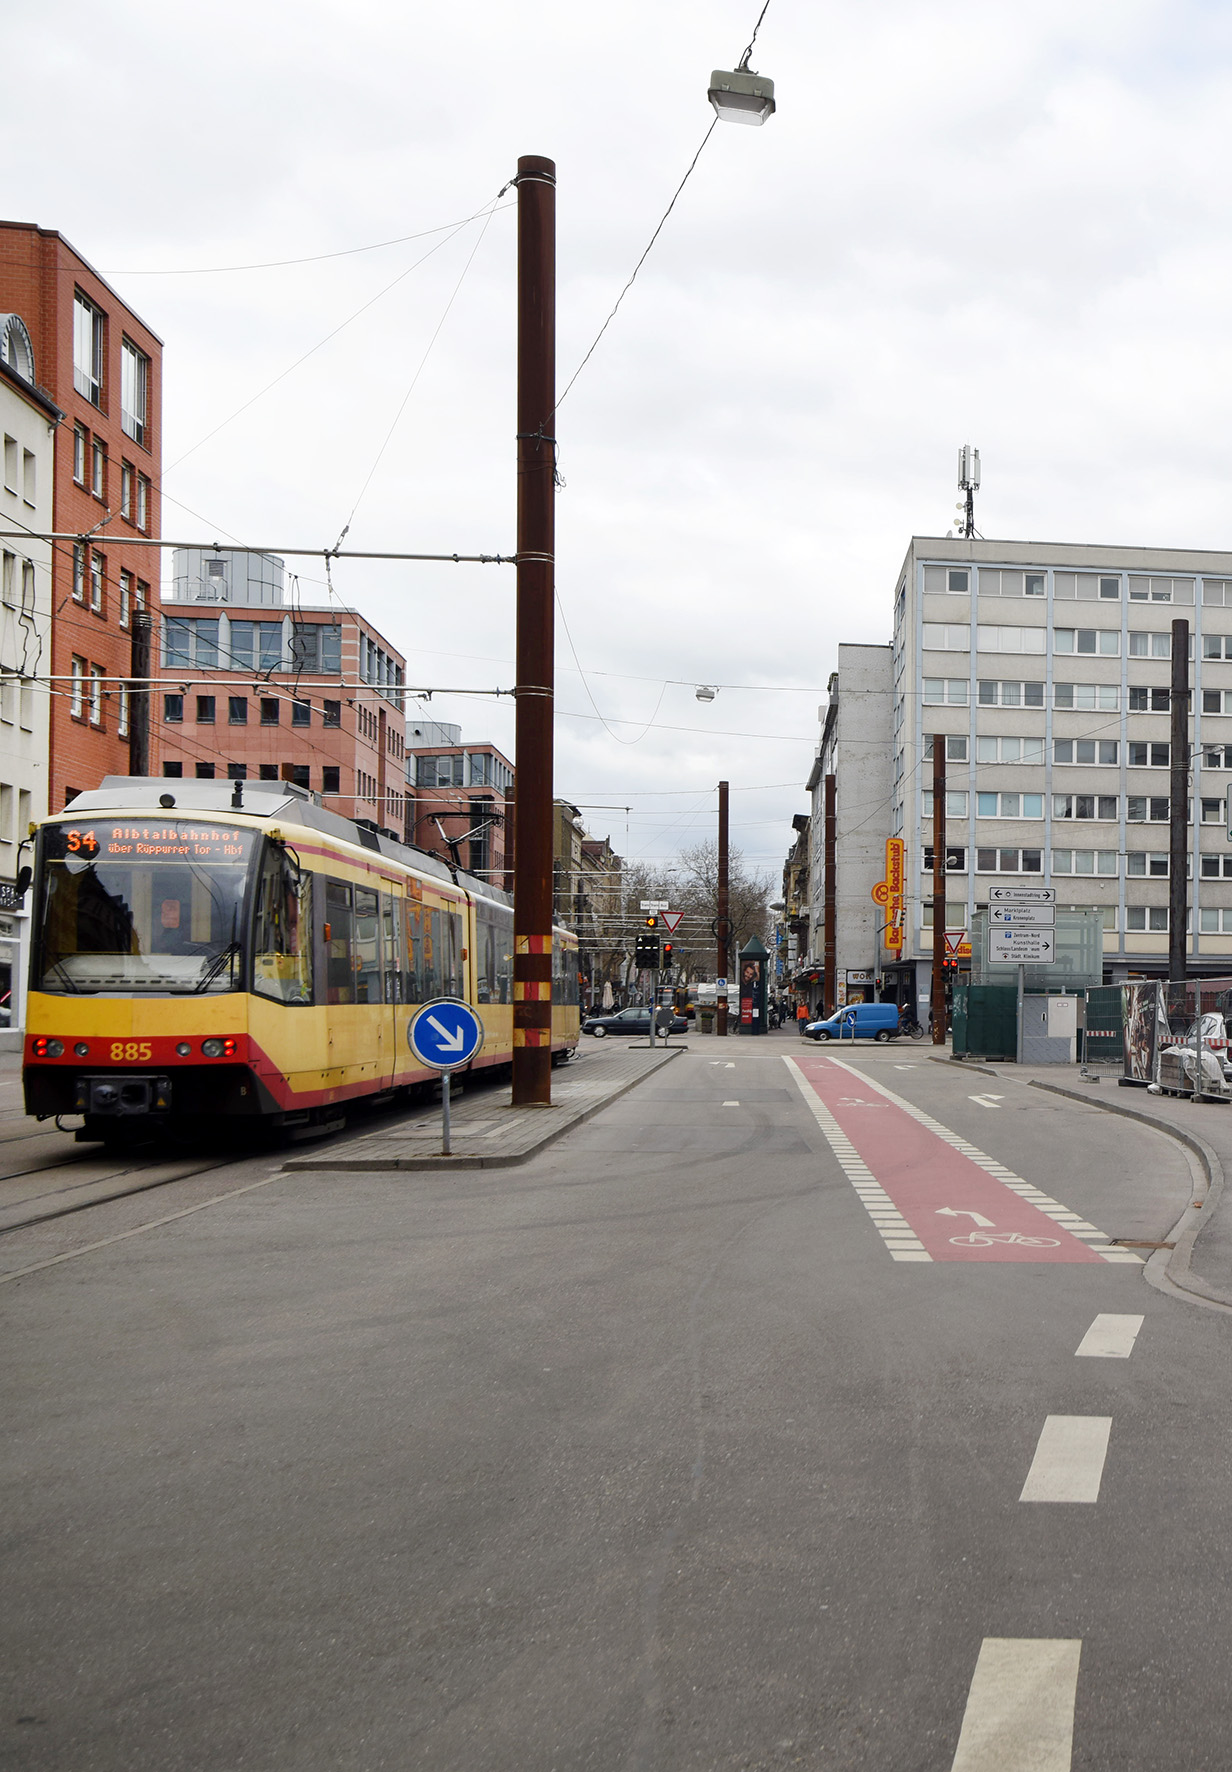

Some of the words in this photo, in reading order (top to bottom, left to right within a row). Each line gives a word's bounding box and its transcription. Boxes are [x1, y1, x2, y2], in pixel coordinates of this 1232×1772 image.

[67, 830, 97, 851] S4
[112, 828, 240, 841] Albtalbahnhof
[108, 843, 133, 853] über
[136, 843, 190, 855] Rüppurrer
[194, 844, 210, 855] Tor
[224, 844, 243, 856] Hbf
[110, 1043, 152, 1061] 885
